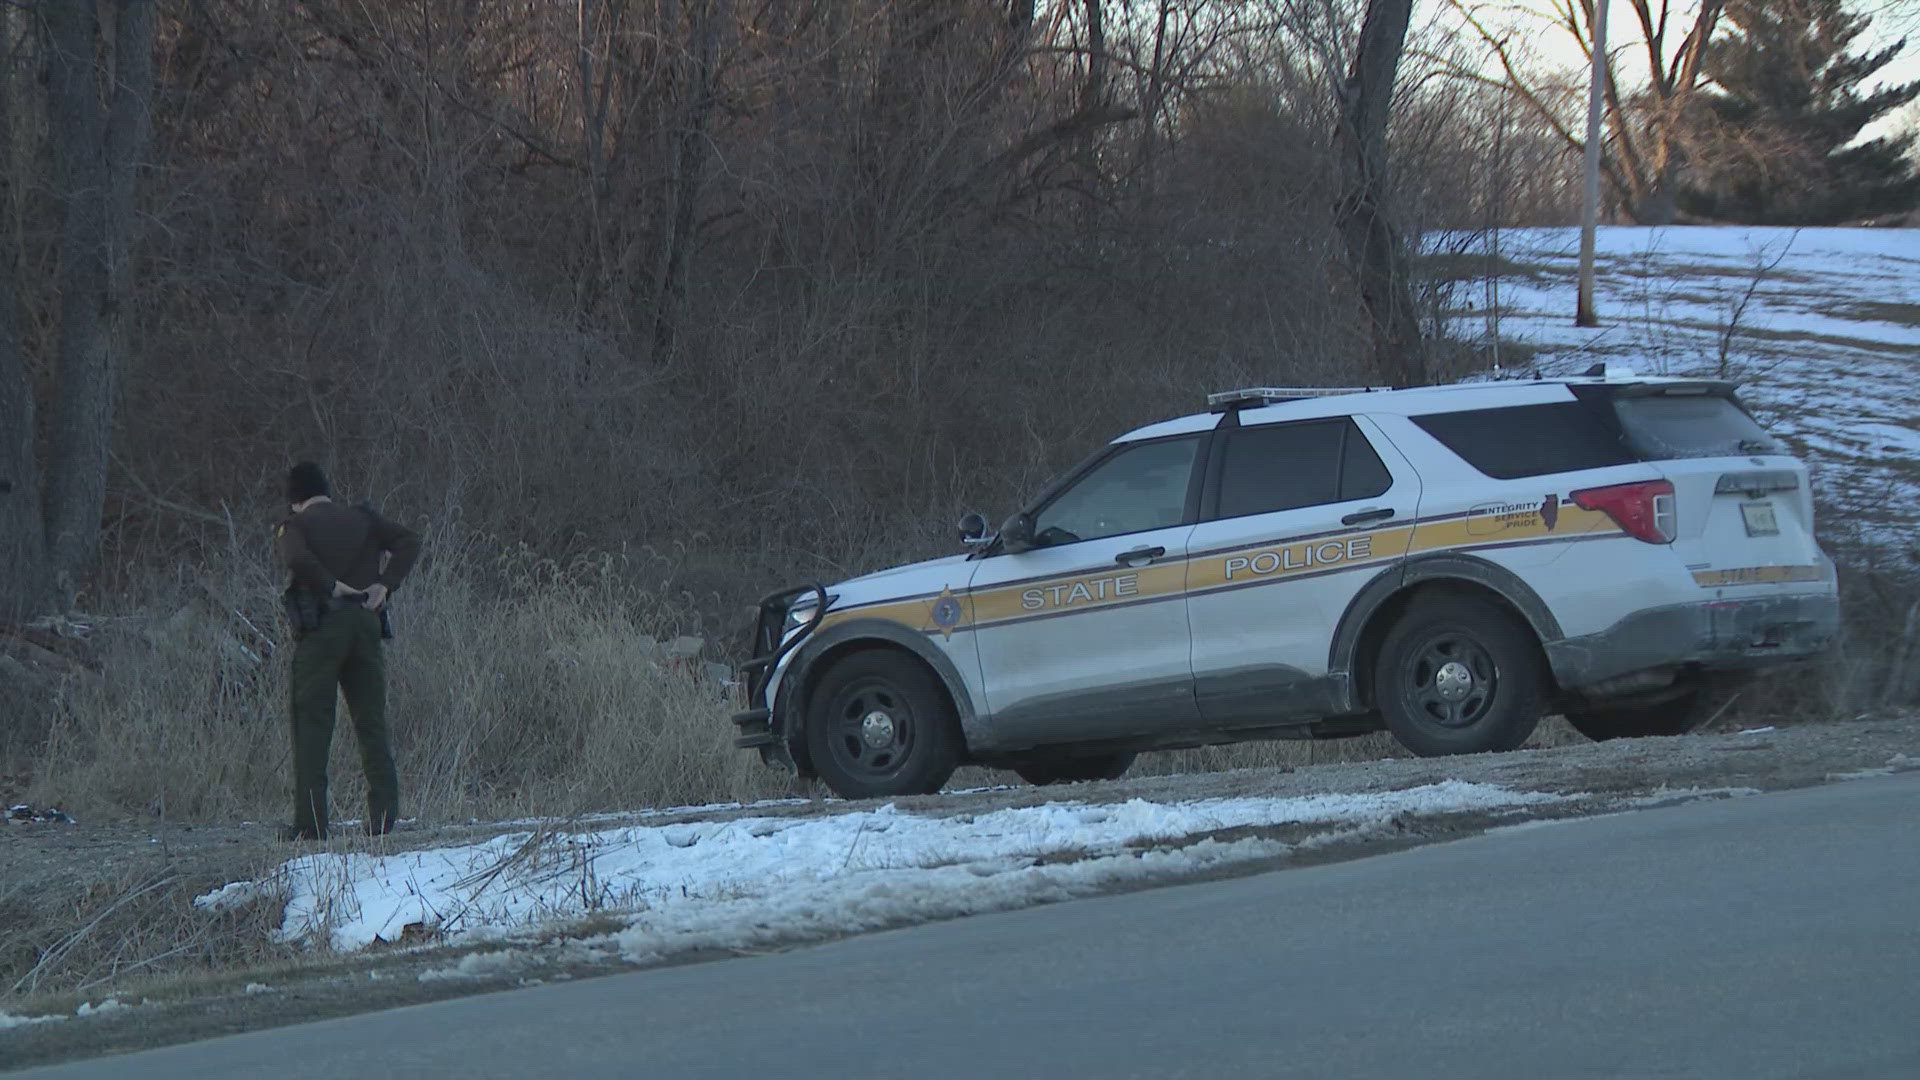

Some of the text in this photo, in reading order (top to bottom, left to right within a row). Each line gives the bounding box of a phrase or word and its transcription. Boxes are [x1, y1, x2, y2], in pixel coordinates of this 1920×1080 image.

[1485, 501, 1539, 515] INTEGRITY
[1494, 510, 1538, 522] SERVICE
[1506, 518, 1537, 529] PRIDE
[1022, 536, 1373, 610] STATE POLICE
